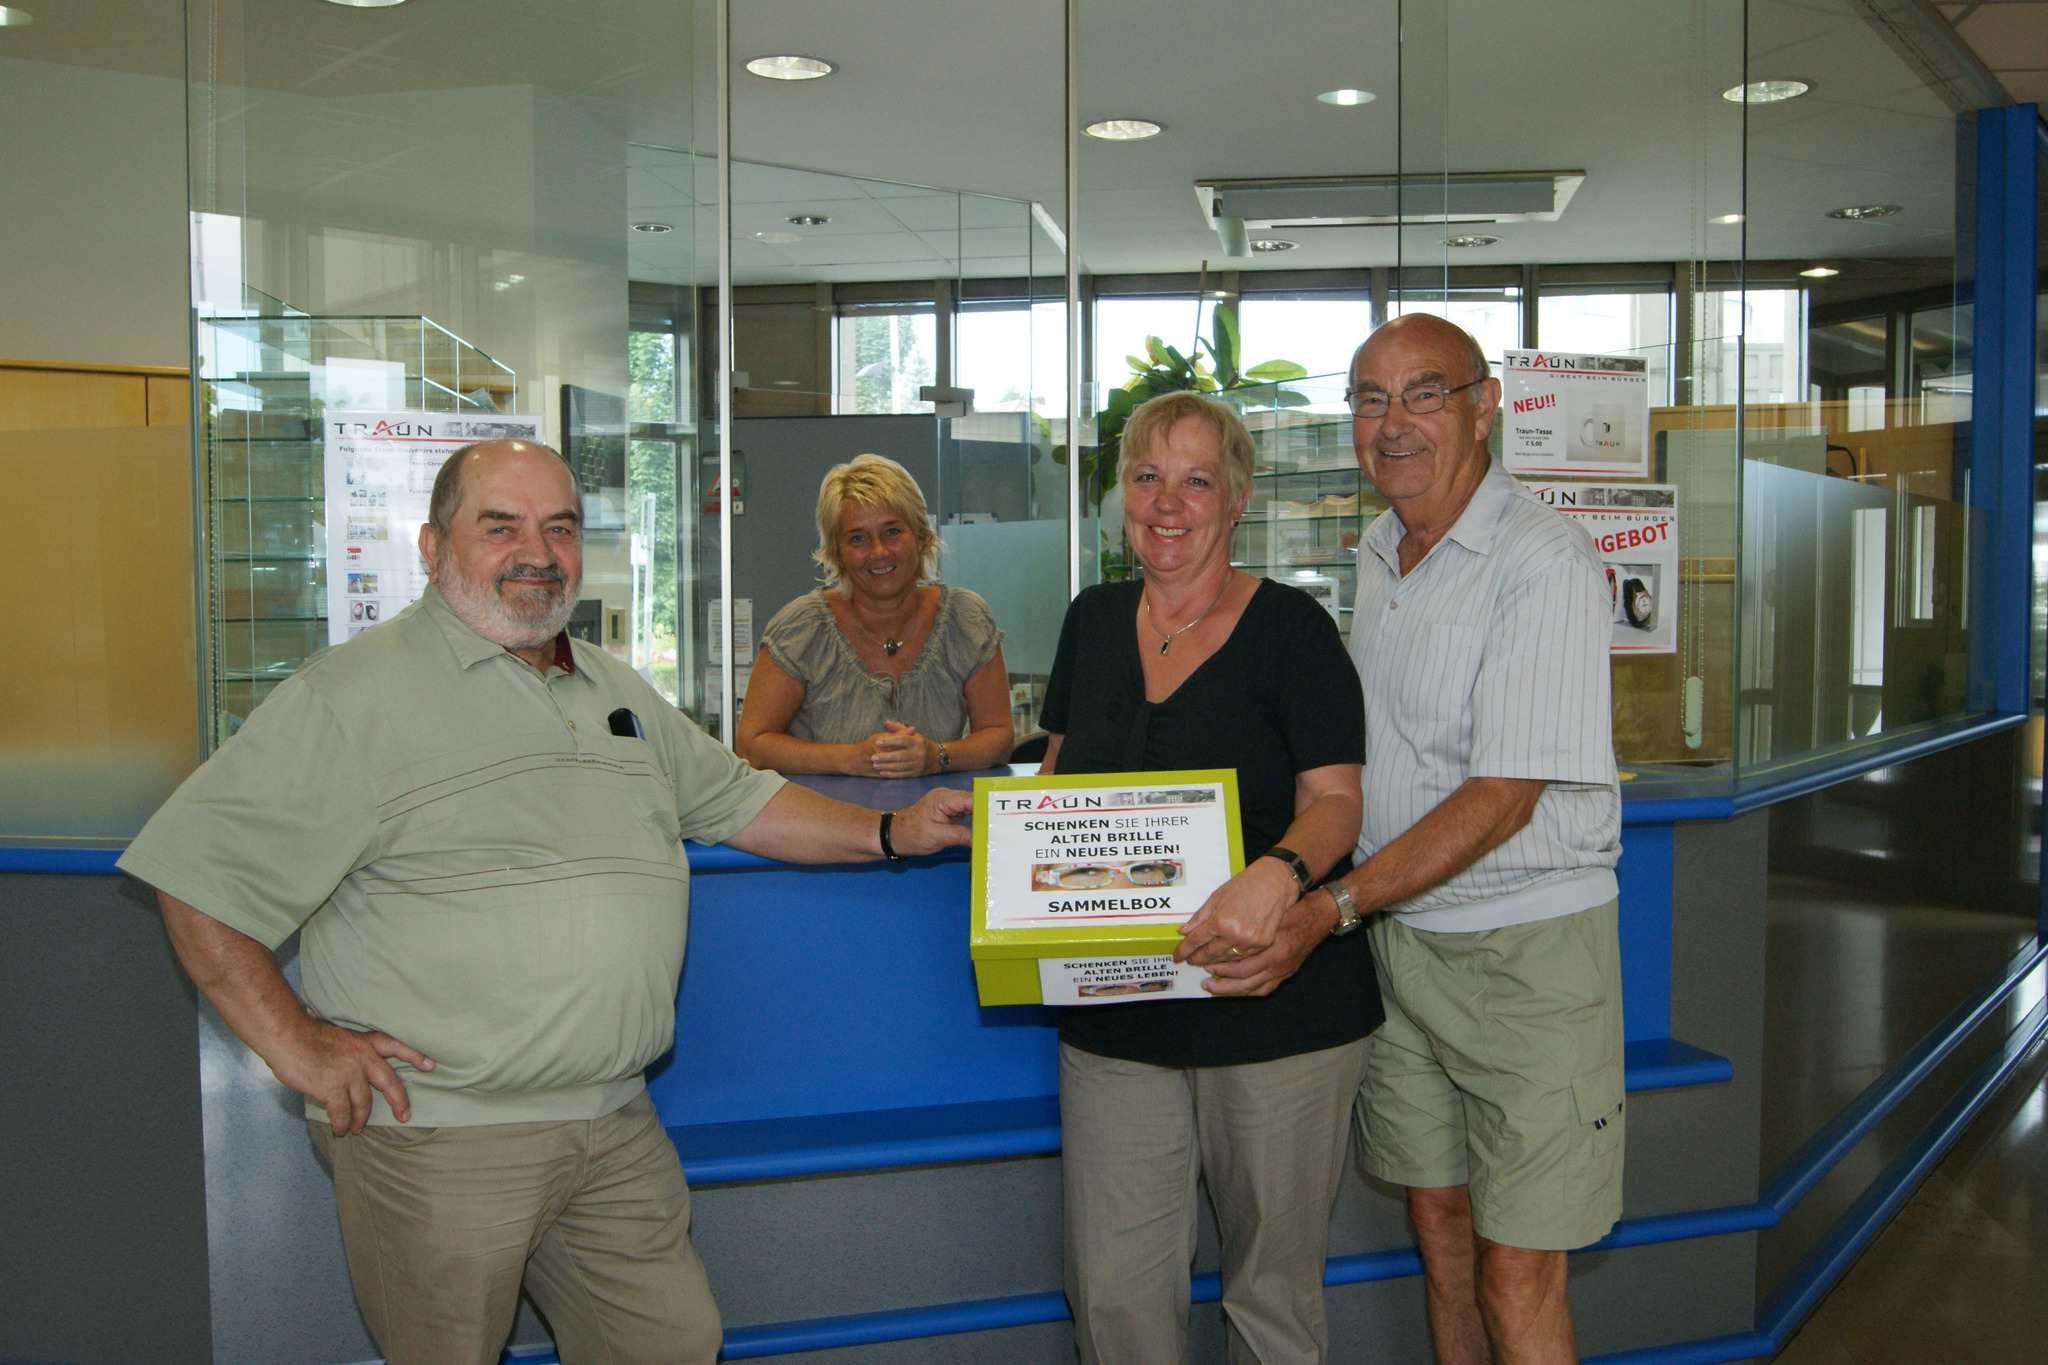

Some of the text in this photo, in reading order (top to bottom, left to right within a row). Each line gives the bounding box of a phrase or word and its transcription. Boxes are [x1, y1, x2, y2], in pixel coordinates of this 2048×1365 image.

[1506, 354, 1575, 369] TRAUN
[1513, 393, 1556, 414] NEU!!
[334, 420, 432, 436] TRAUN
[1515, 427, 1553, 435] Traun-Tasse
[1626, 513, 1675, 522] BÜRGER
[996, 795, 1102, 811] TRAUN
[1024, 816, 1190, 831] SCHENKEN SIE IHRER
[1051, 831, 1164, 844] ALTEN BRILLE
[1035, 844, 1180, 859] EIN NEUES LEBEN!
[1048, 897, 1172, 913] SAMMELBOX
[1063, 960, 1127, 970] SCHENKEN
[1084, 964, 1167, 976] ALTEN BRILLE
[1095, 974, 1134, 982] NEUES
[1137, 970, 1179, 979] LEBEN!
